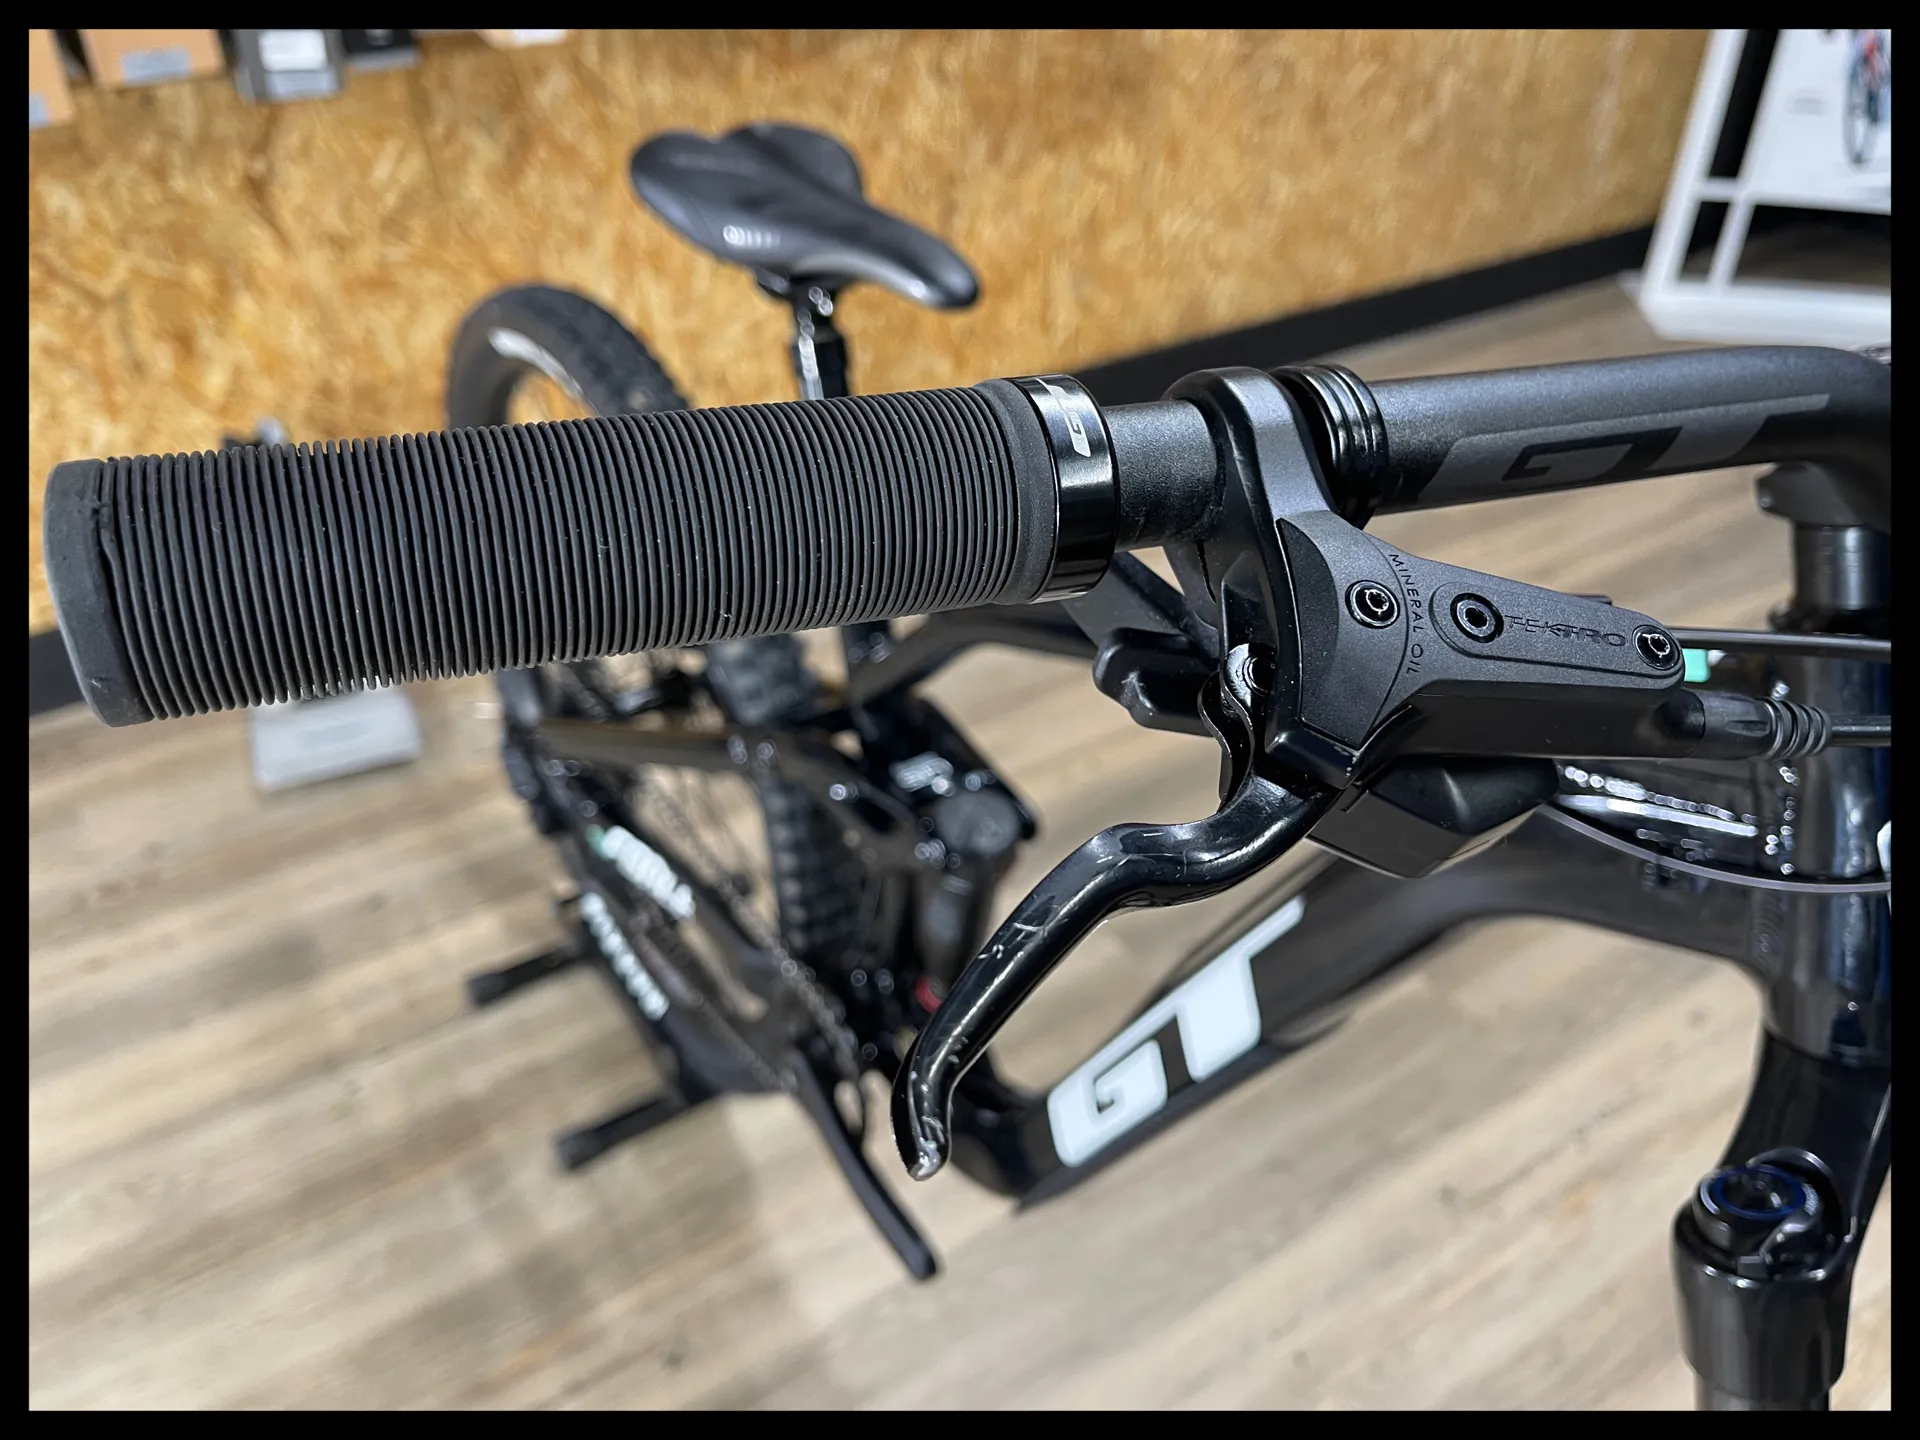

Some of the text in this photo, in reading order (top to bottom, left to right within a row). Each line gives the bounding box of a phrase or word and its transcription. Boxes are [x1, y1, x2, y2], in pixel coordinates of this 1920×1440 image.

[1035, 378, 1091, 457] GT
[1417, 394, 1829, 502] GT
[1388, 554, 1424, 674] MINERAL OIL
[1503, 614, 1628, 646] TEKTRO
[1047, 895, 1304, 1168] GT
